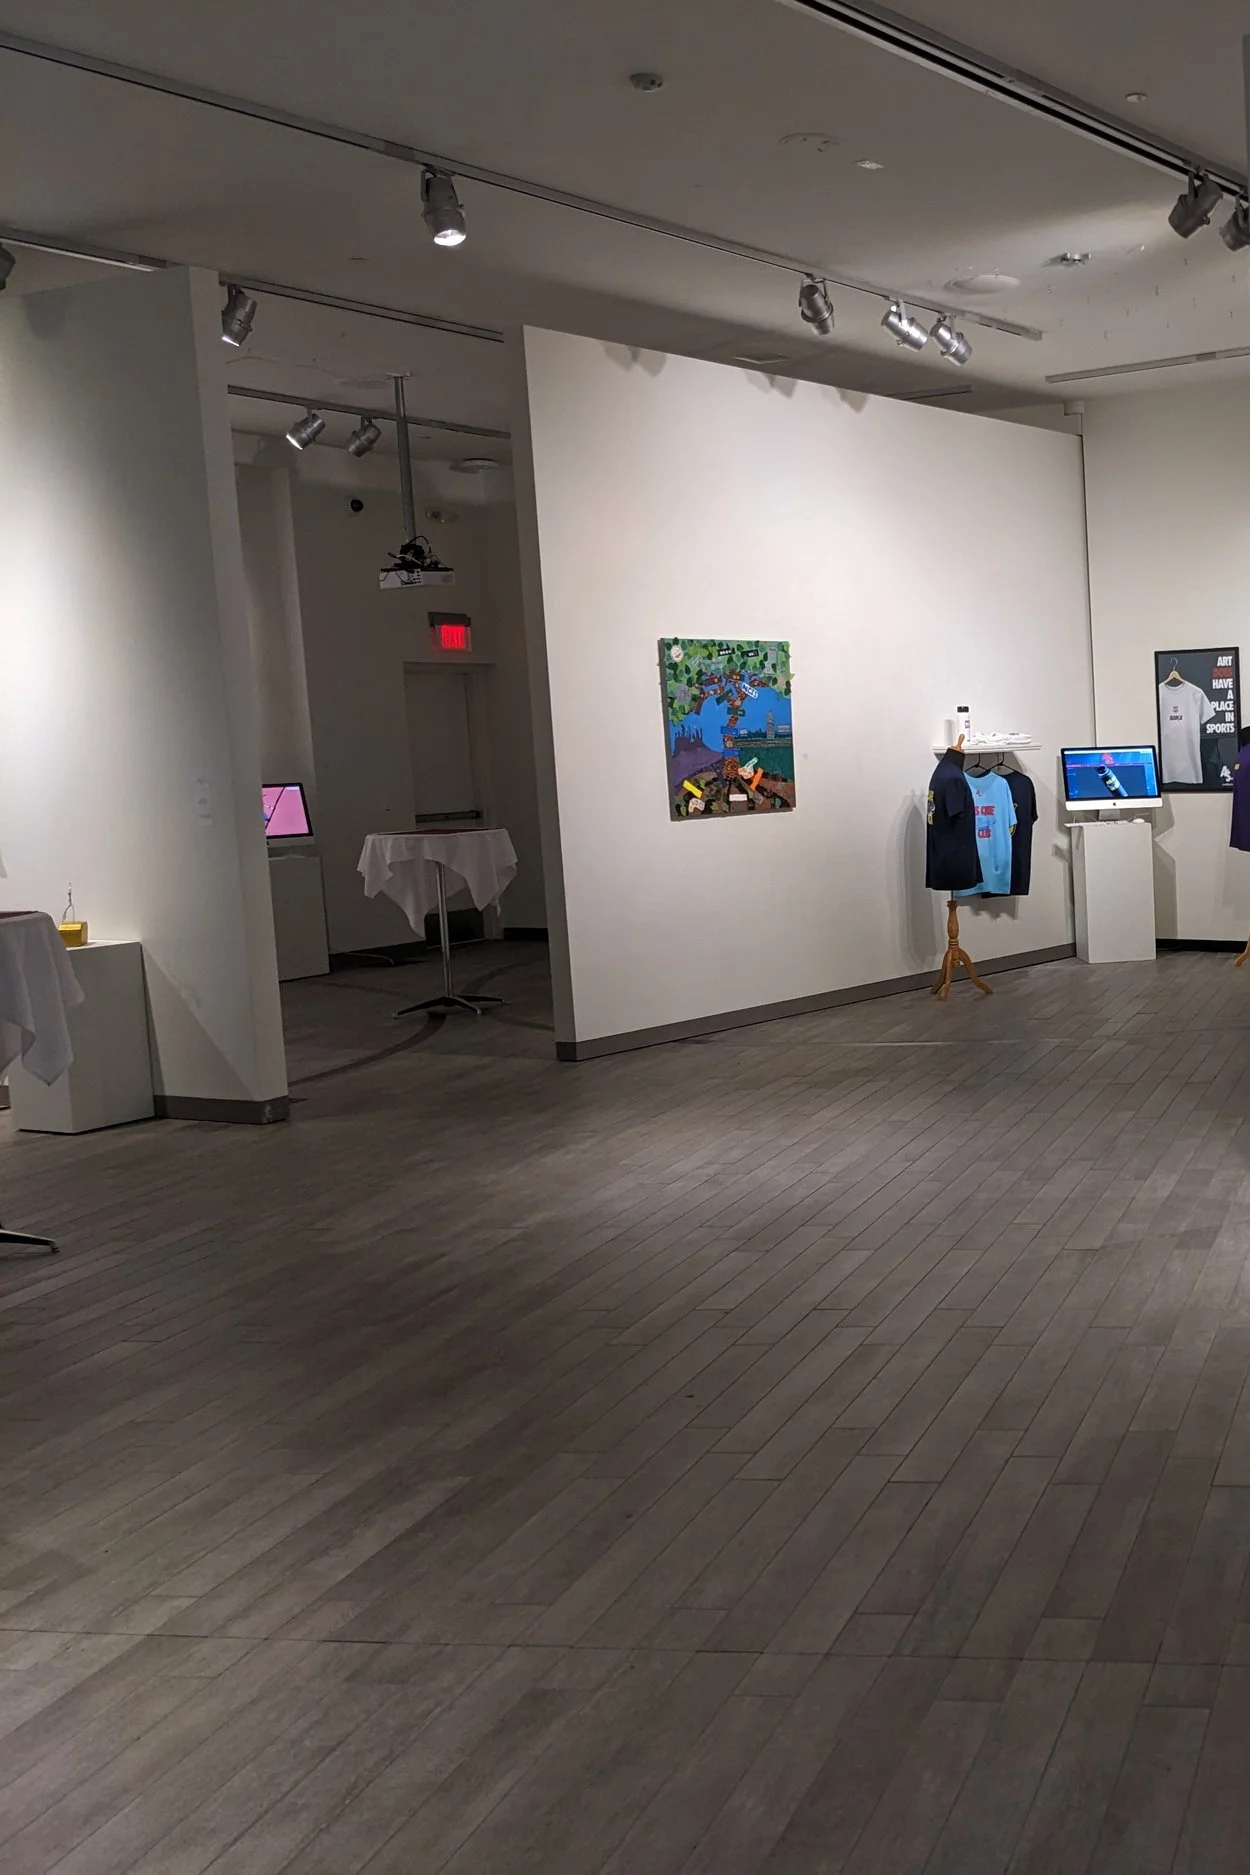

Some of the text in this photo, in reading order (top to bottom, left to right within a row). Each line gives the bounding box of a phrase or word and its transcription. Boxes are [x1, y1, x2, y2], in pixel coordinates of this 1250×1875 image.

[1216, 656, 1233, 667] ART
[1212, 678, 1234, 689] HAVE
[1227, 690, 1234, 700] A
[1211, 701, 1235, 712] PLACE
[1225, 712, 1235, 722] IN
[1206, 723, 1235, 734] SPORTS
